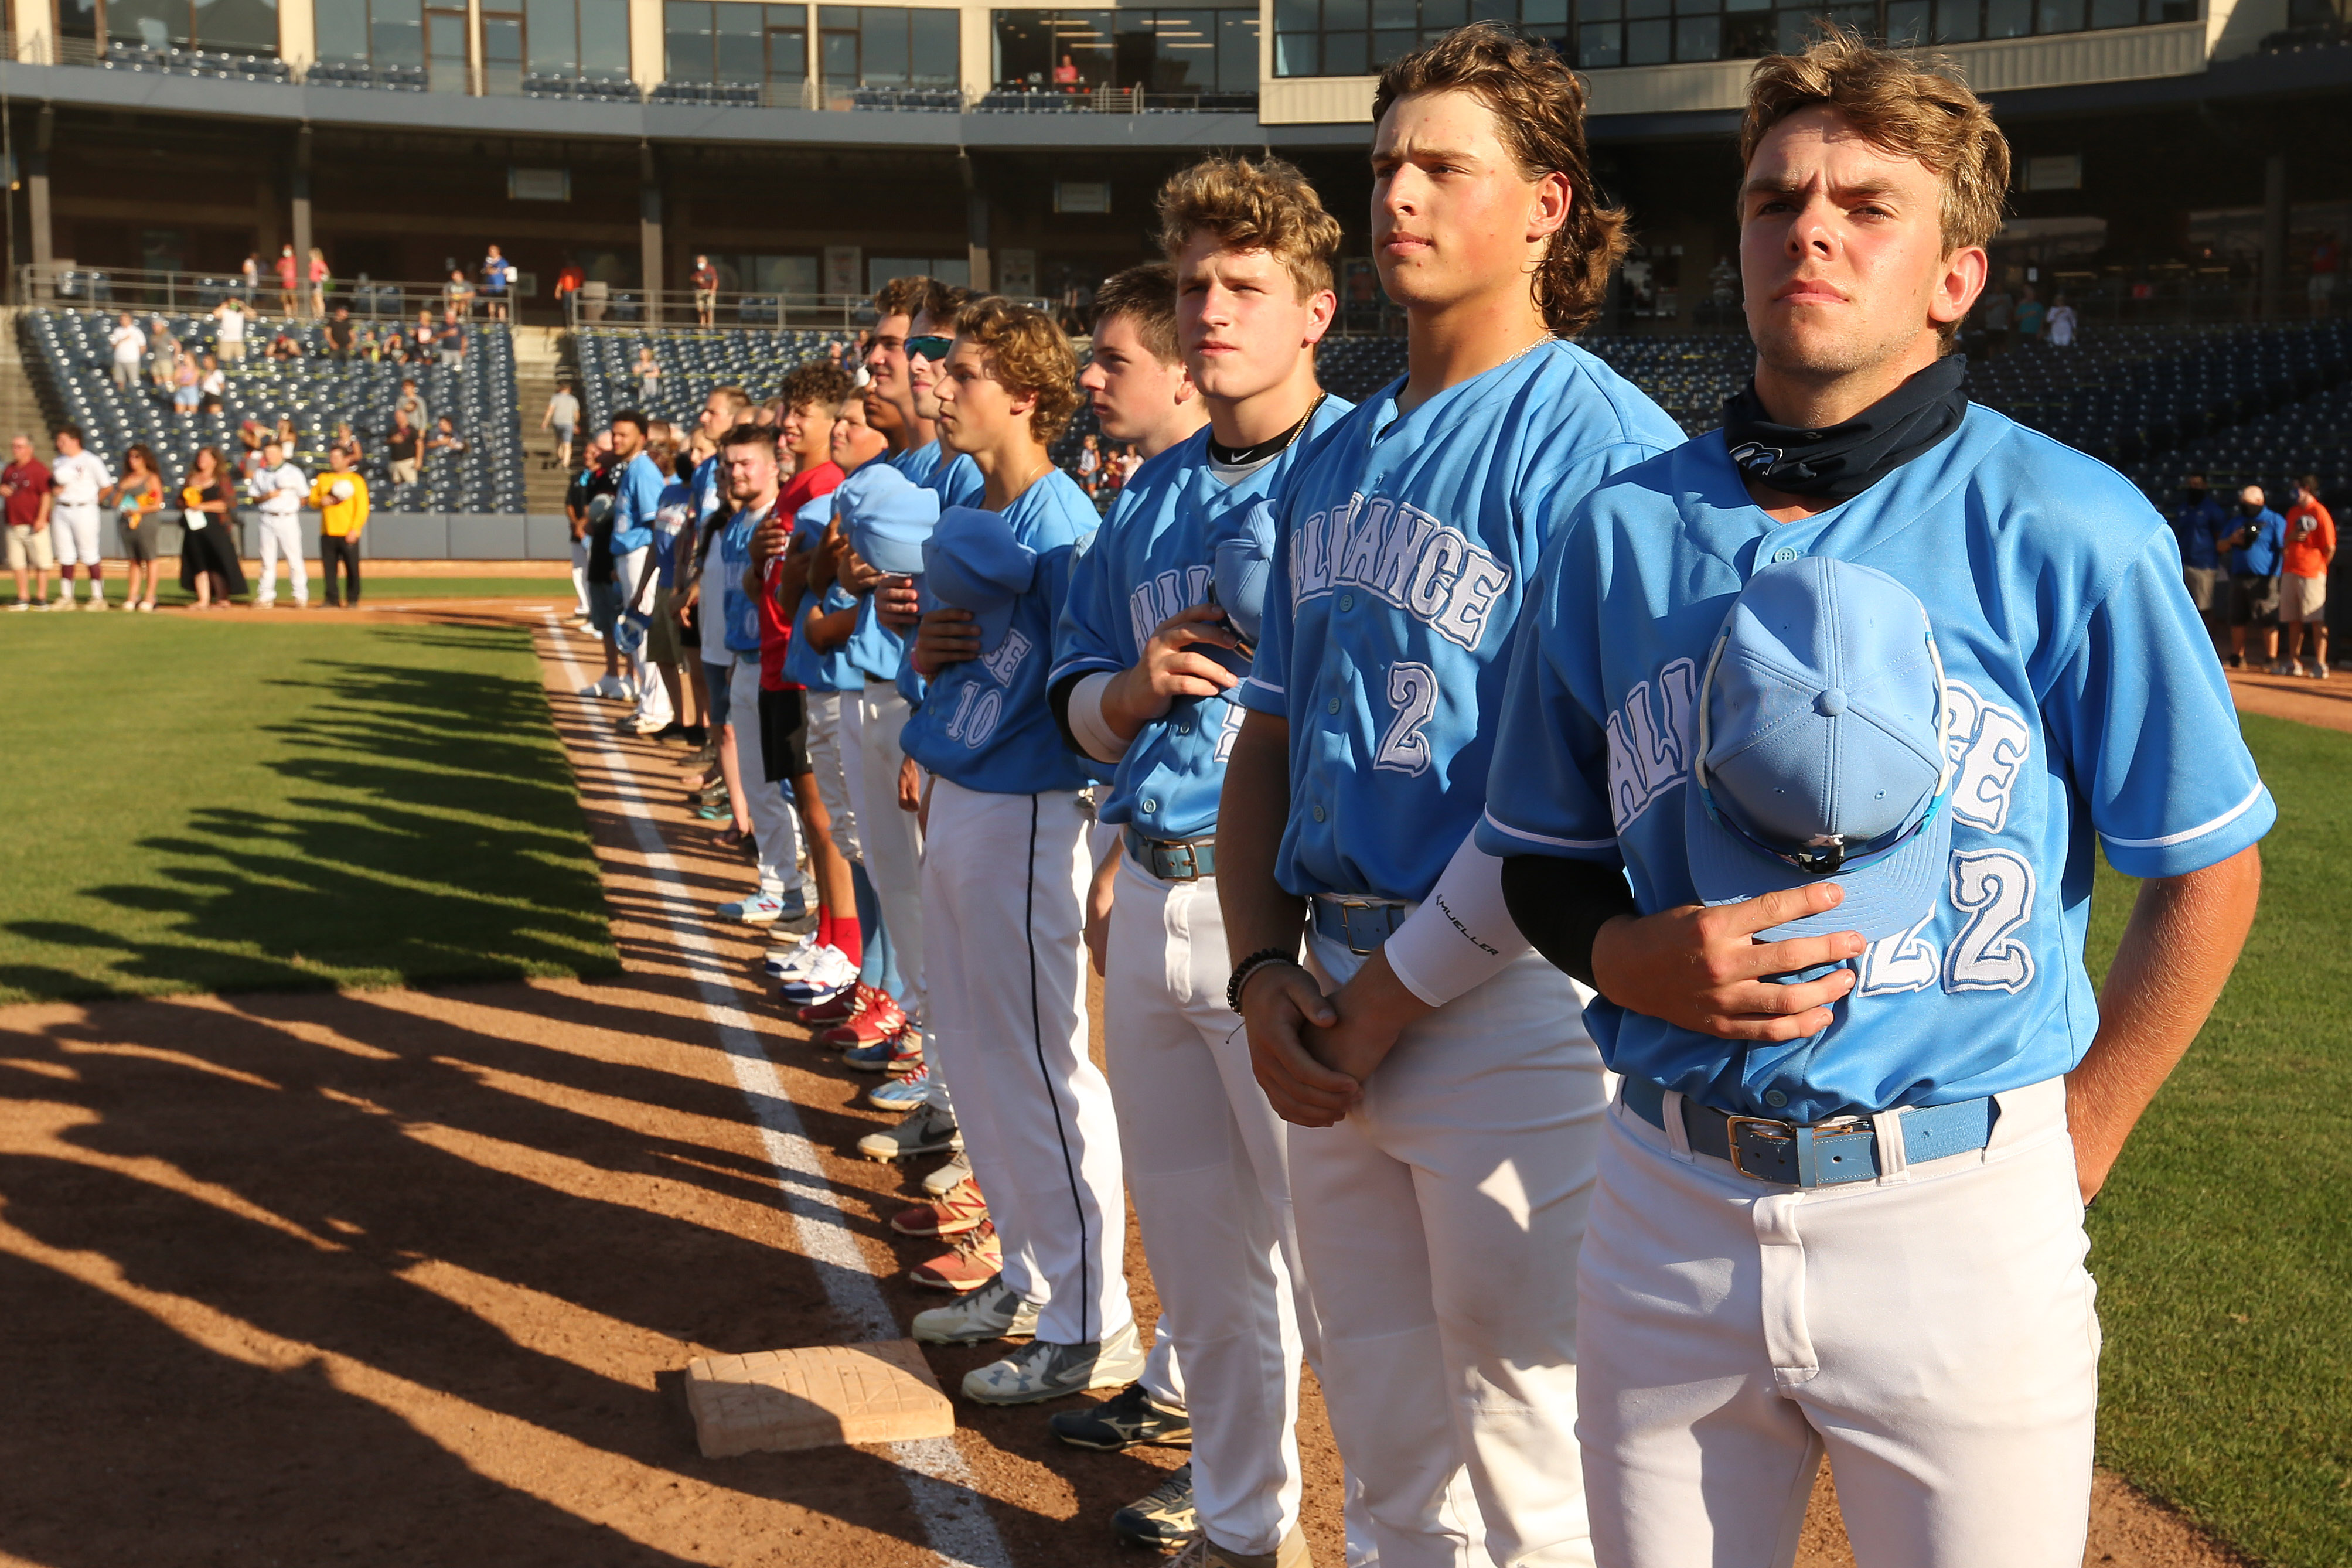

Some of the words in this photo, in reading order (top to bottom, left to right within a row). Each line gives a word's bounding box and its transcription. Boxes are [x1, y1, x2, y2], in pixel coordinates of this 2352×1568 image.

[947, 681, 1001, 749] 10
[1373, 661, 1439, 778] 2
[1439, 900, 1499, 956] MUELLER
